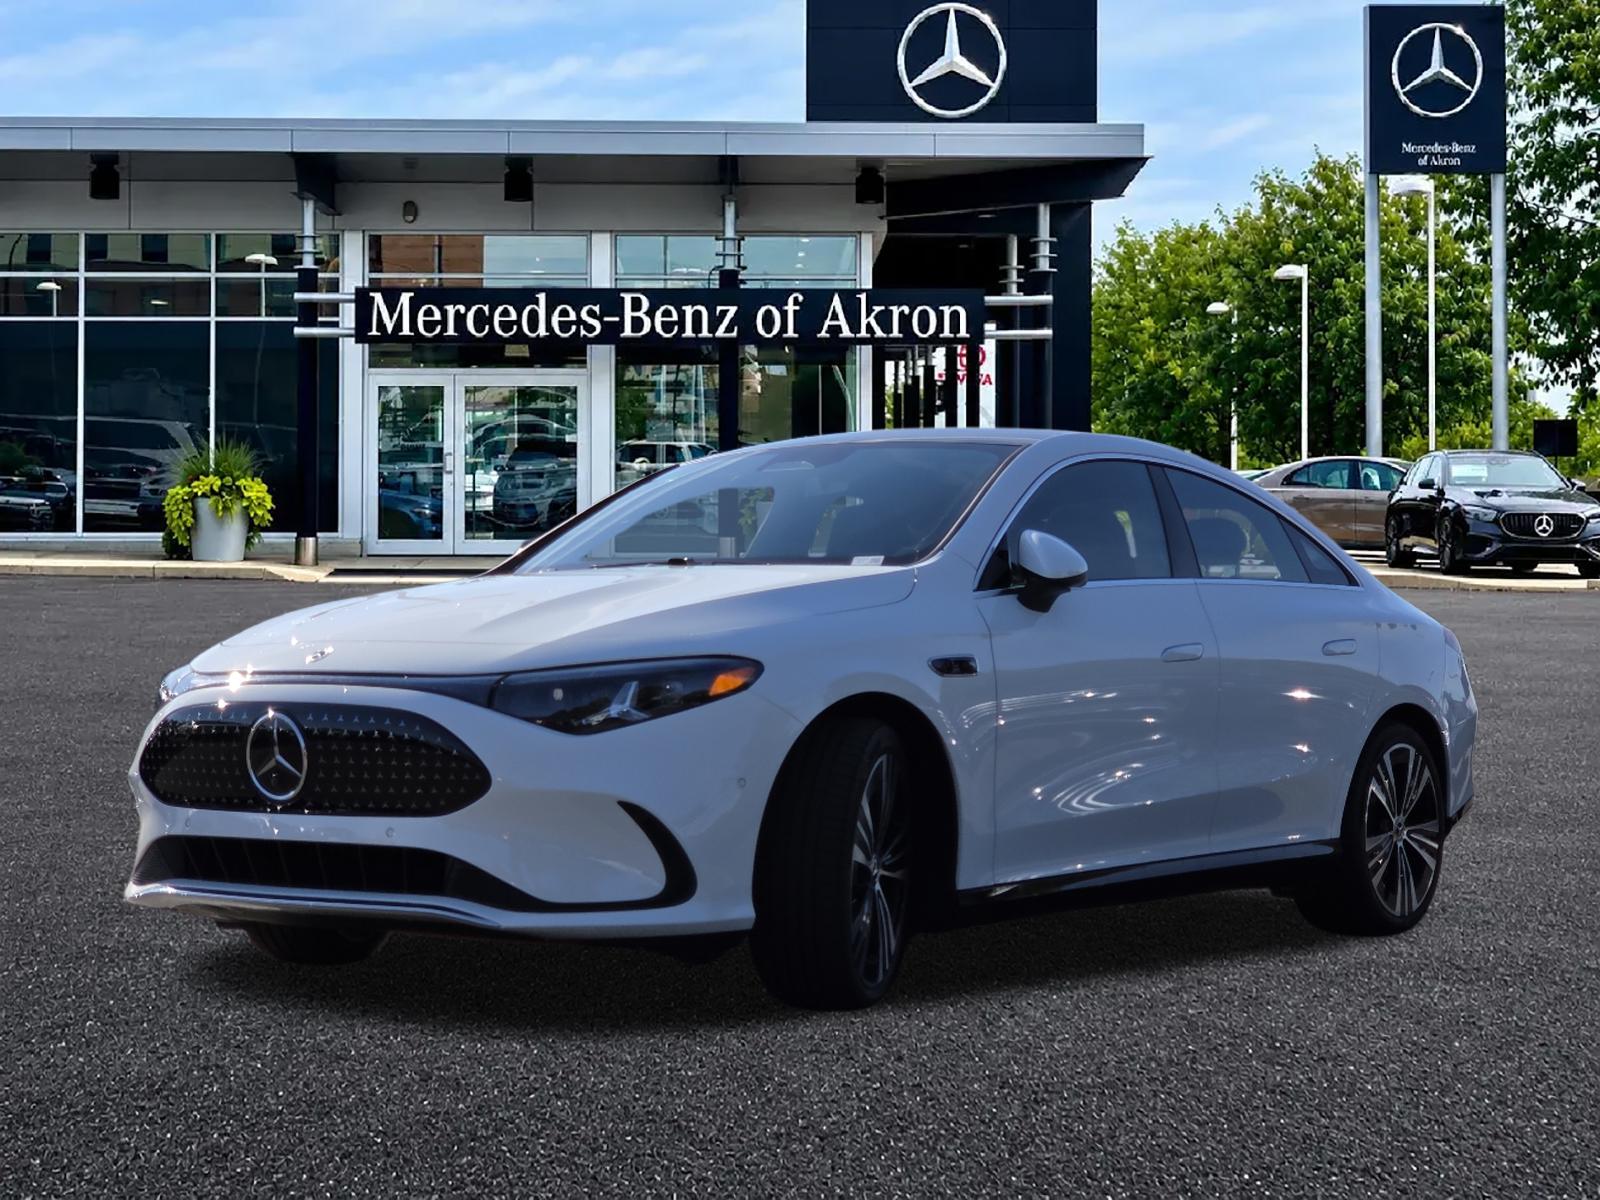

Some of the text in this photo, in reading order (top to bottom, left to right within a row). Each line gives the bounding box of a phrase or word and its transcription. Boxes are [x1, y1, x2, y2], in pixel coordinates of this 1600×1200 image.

[1401, 141, 1477, 154] Mercedes-Benz
[1417, 154, 1461, 166] of Akron
[367, 291, 971, 338] Mercedes-Benz of Akron
